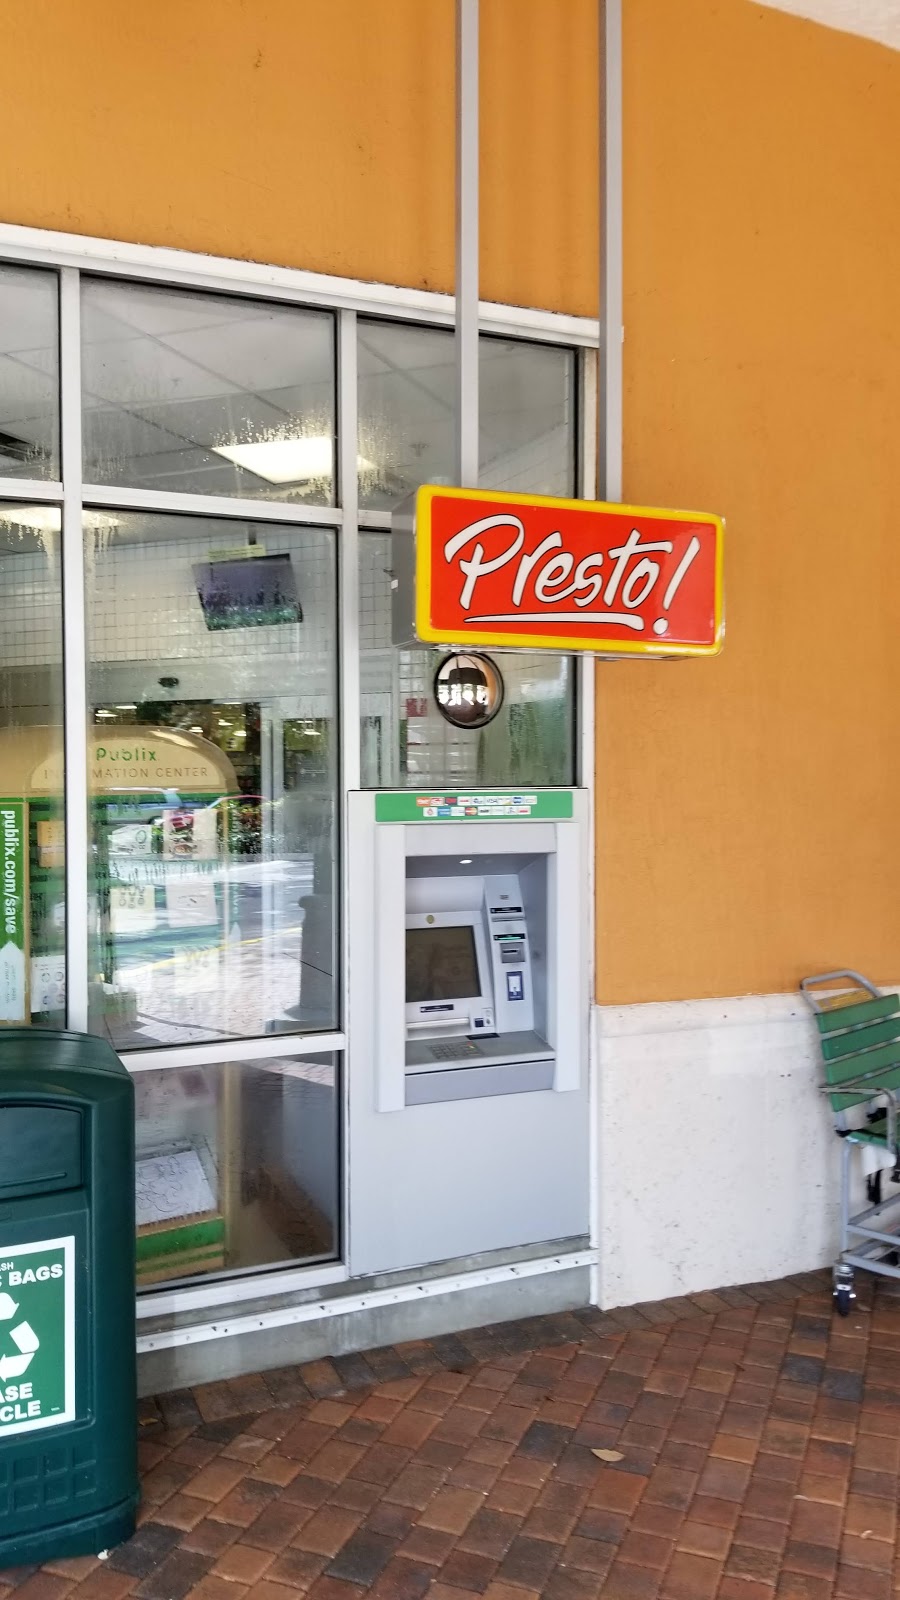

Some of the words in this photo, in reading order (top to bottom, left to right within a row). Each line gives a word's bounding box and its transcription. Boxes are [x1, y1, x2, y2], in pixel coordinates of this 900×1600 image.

[444, 513, 701, 635] Presto!
[96, 747, 157, 762] Publix
[156, 767, 208, 778] CENTER
[1, 810, 20, 934] publix.com/save
[0, 1261, 14, 1271] SH
[9, 1263, 64, 1287] BAGS
